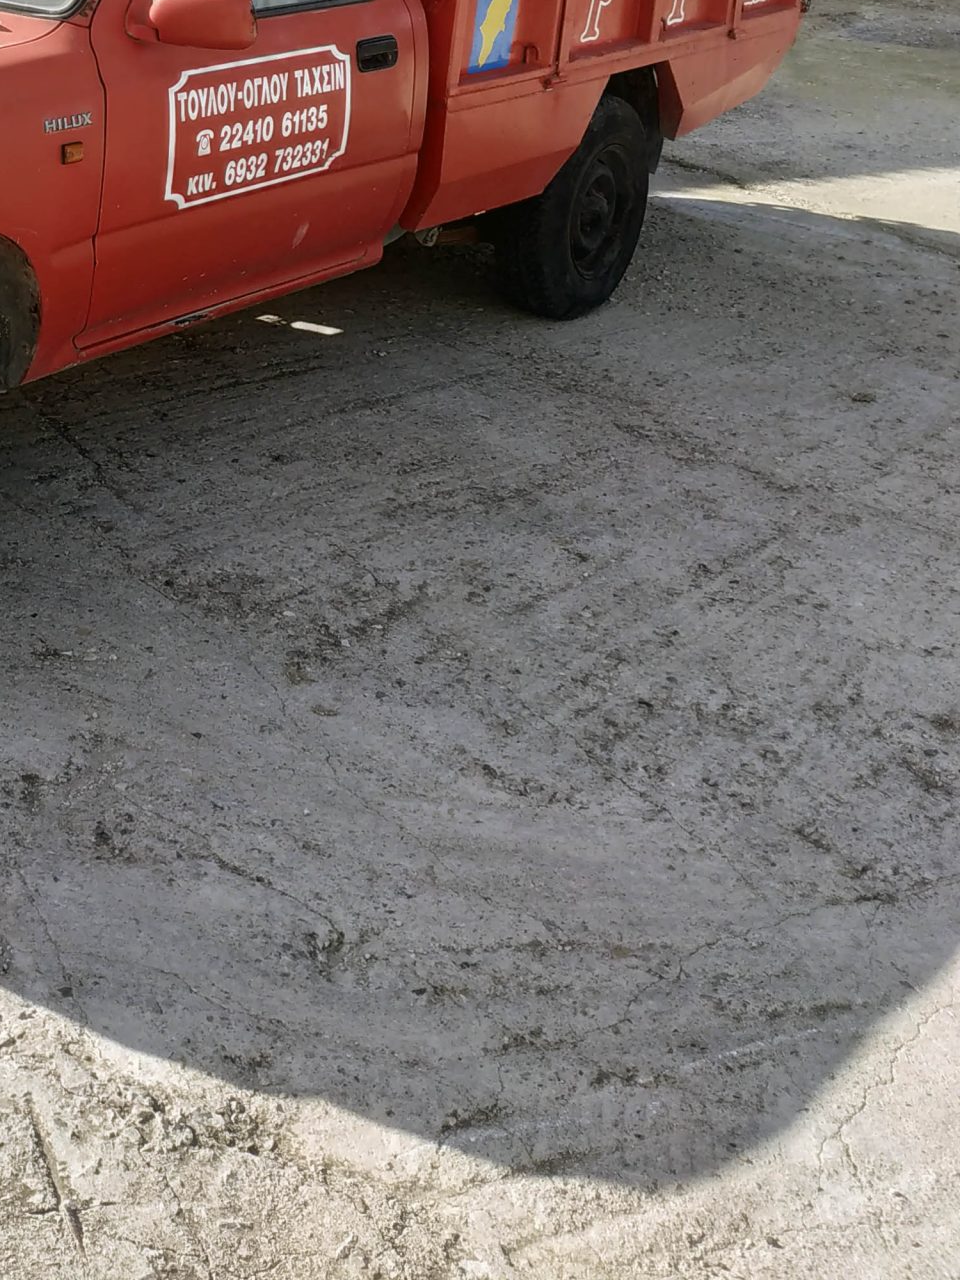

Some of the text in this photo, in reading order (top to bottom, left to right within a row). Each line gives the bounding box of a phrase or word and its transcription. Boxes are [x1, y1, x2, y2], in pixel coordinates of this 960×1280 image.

[294, 61, 345, 98] ΤΑΧΣΙΝ
[44, 112, 92, 133] HILUX
[219, 104, 328, 152] 22410 61135
[224, 152, 268, 186] 6932
[273, 138, 330, 173] 732331
